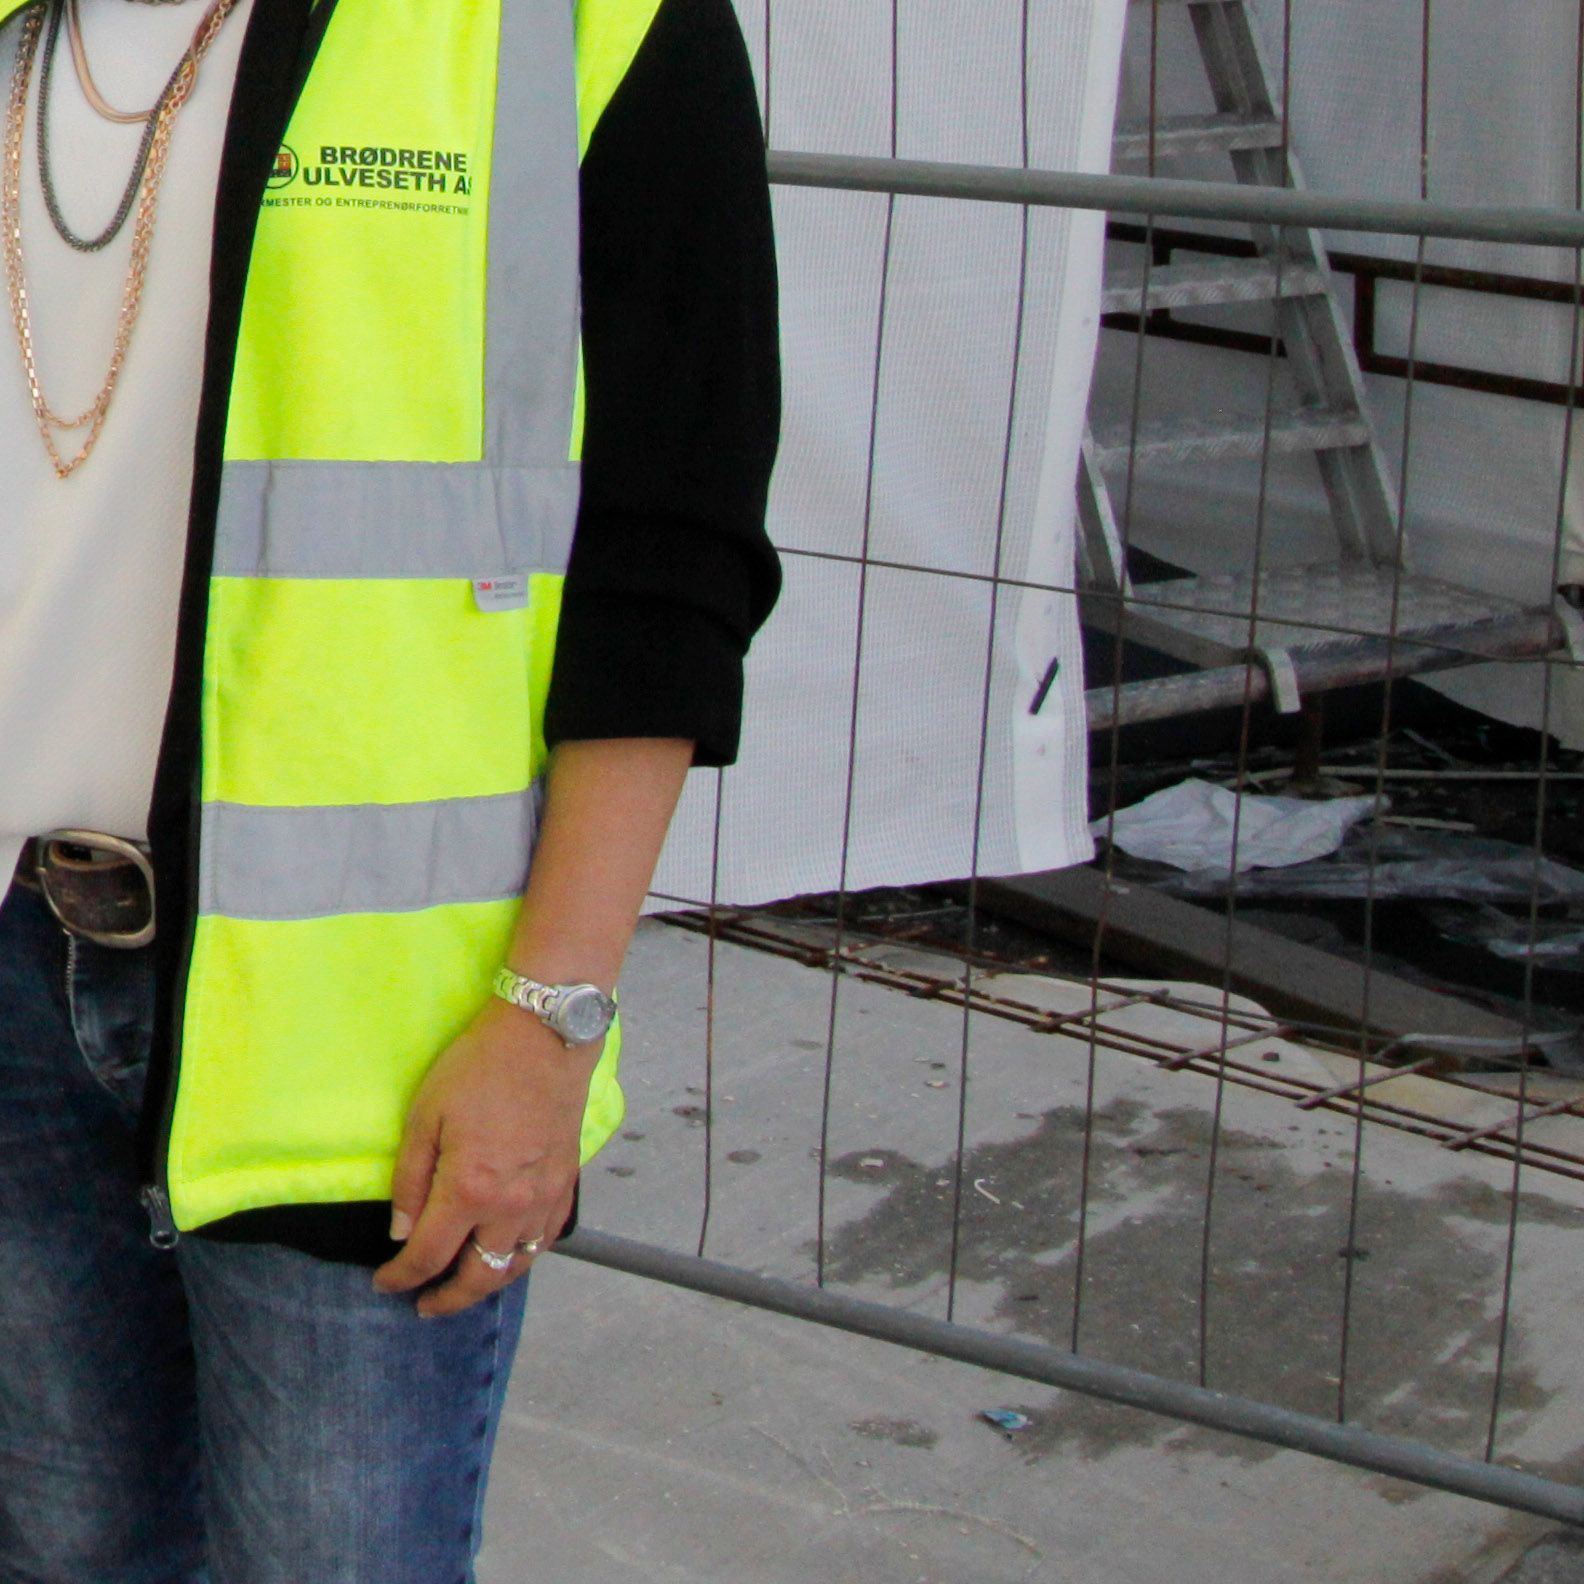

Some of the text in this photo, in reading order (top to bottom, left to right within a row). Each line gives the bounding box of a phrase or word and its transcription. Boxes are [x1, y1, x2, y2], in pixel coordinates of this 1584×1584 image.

[320, 146, 467, 173] BRØDRENE
[304, 167, 445, 193] ULVESETH
[316, 197, 332, 207] OG
